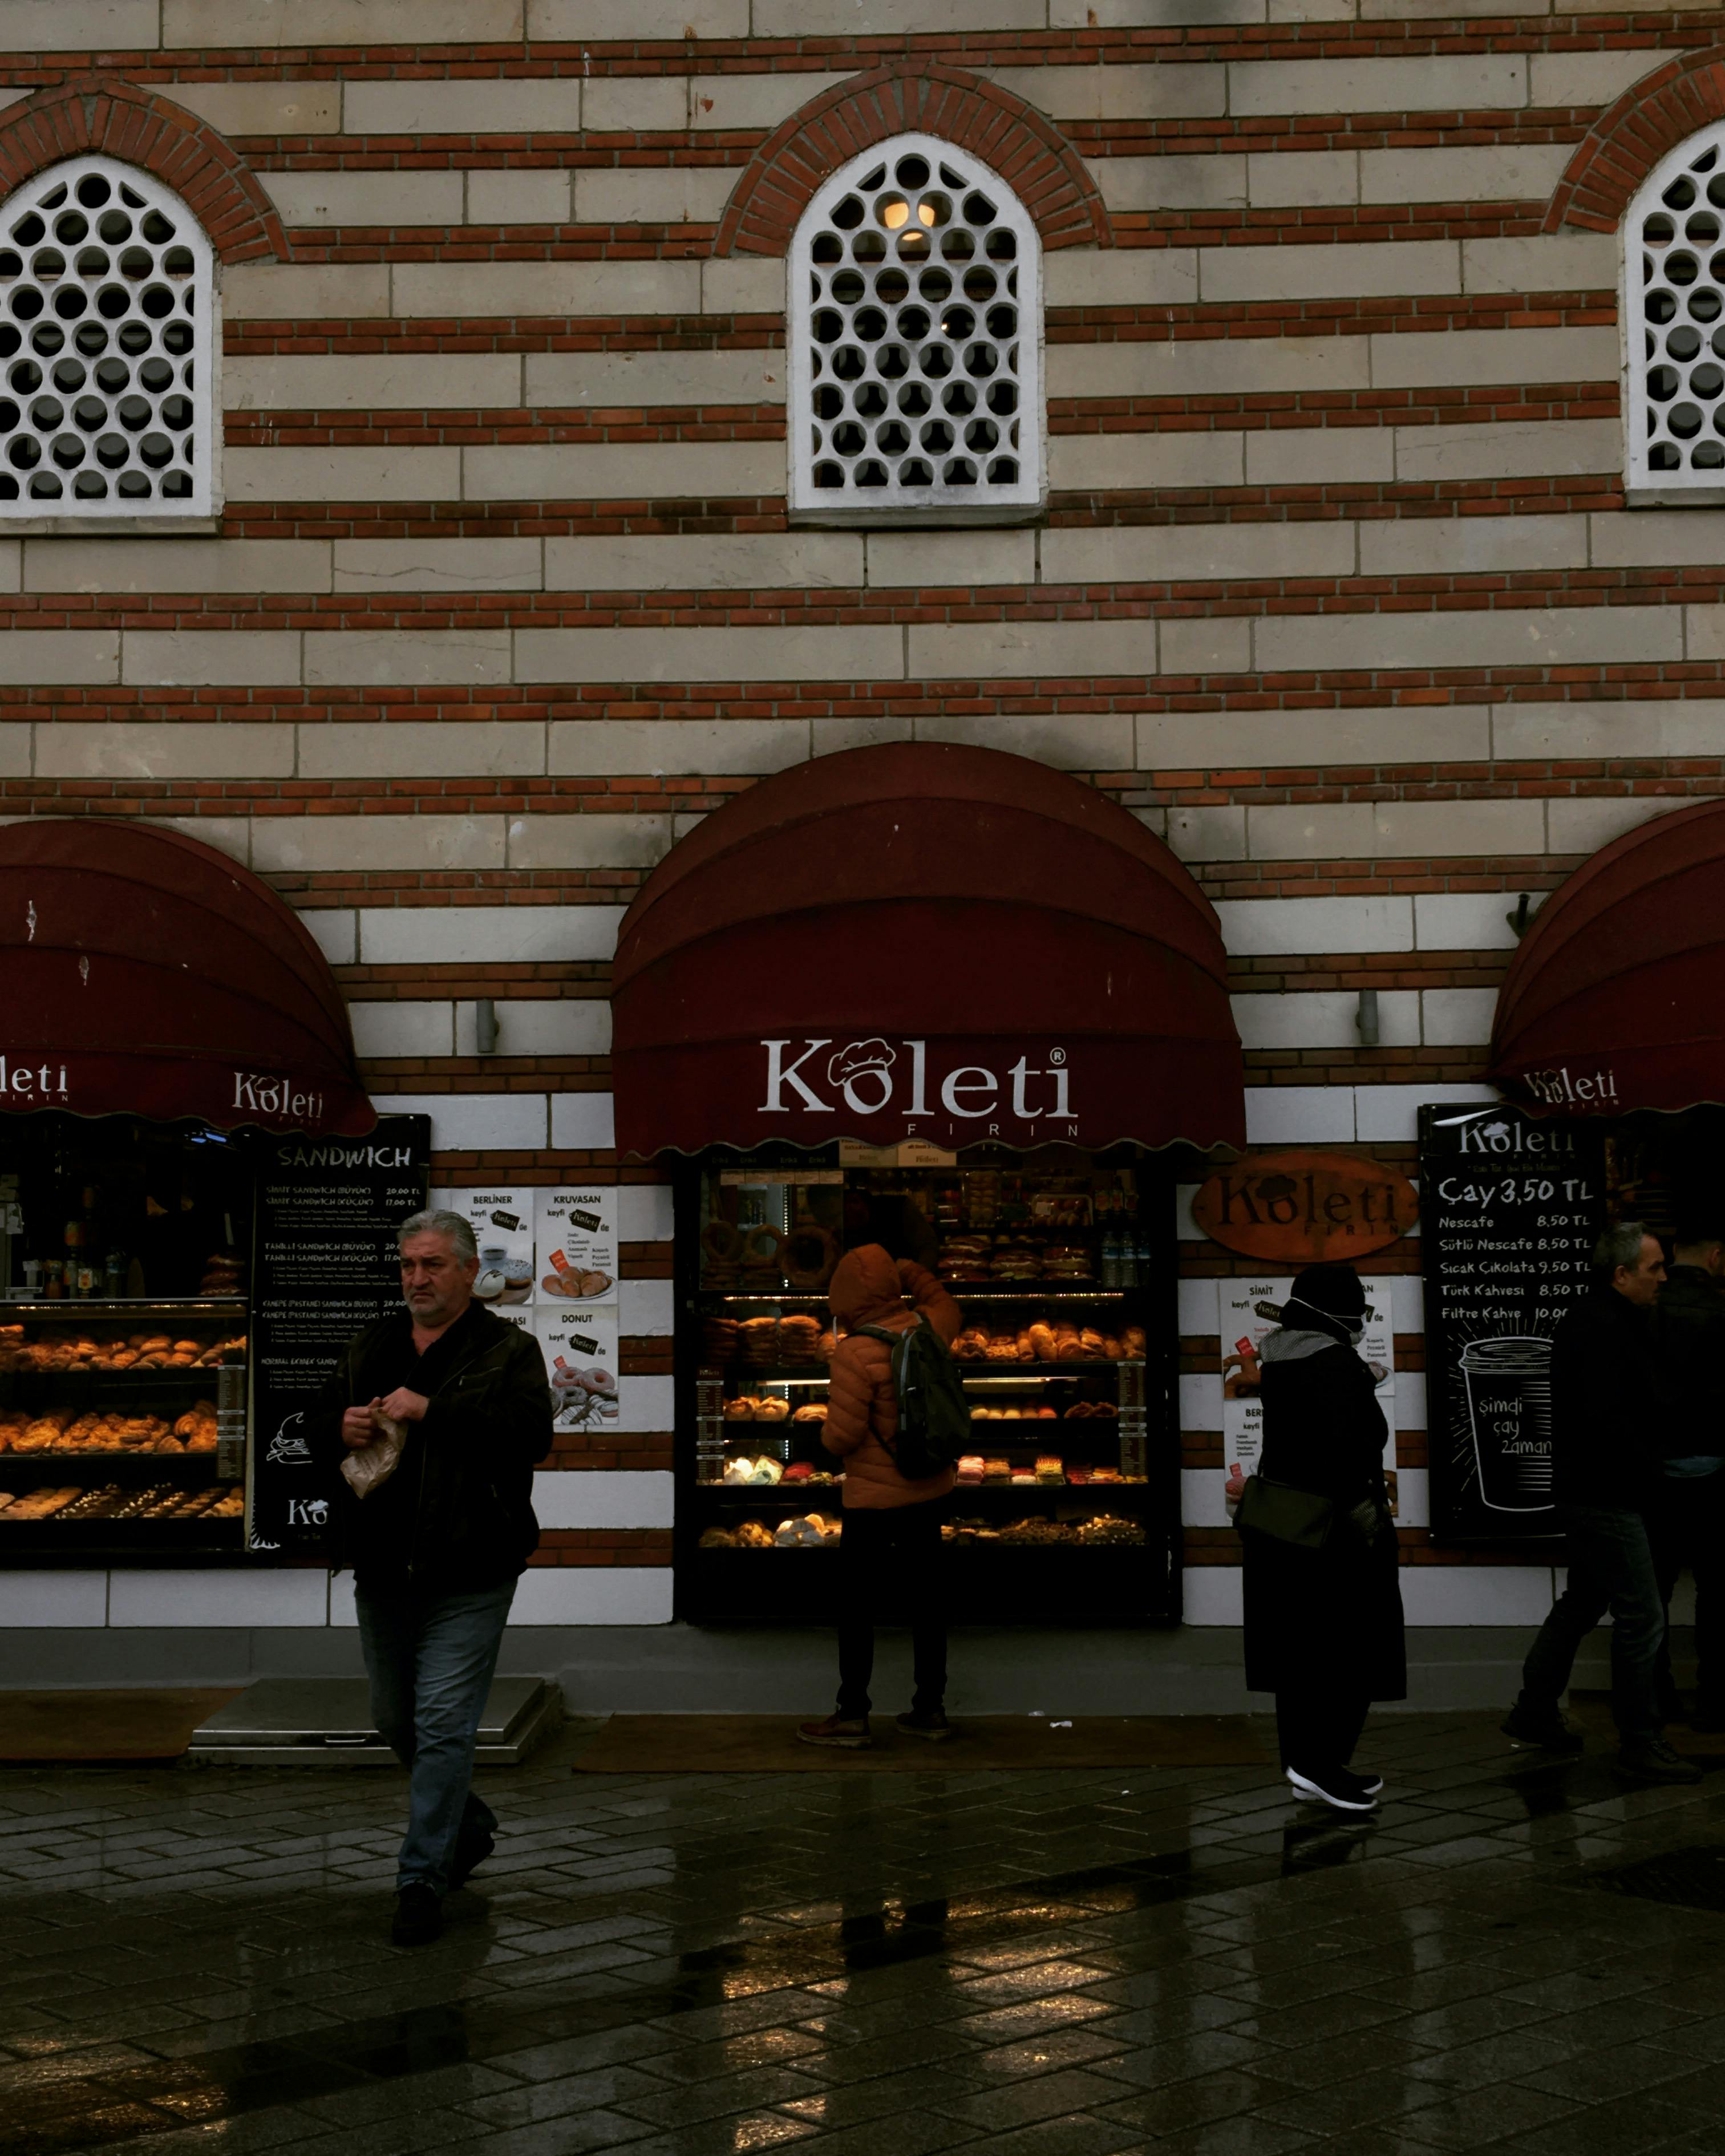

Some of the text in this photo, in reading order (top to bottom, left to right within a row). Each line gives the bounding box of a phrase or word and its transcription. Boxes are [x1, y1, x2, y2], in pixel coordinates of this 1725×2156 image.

[907, 1123, 1078, 1136] FIRIN
[276, 1145, 411, 1168] SANDWICH
[473, 1194, 512, 1204] BERLİNER
[1438, 1177, 1594, 1209] Çay 3,50 TL
[1439, 1215, 1495, 1228] Nescafe
[1572, 1215, 1591, 1226] TL
[1305, 1225, 1399, 1235] FIRIN
[1439, 1238, 1473, 1250] Sütlü
[1477, 1238, 1533, 1250] Nescafe
[1573, 1238, 1592, 1249] TL
[1440, 1261, 1475, 1274] Sıcak
[1479, 1261, 1536, 1275] Çikolata
[1574, 1261, 1592, 1272] TL
[1249, 1284, 1273, 1295] SİMİT
[1440, 1284, 1471, 1296] Türk
[1474, 1284, 1525, 1296] Kahvesi
[1232, 1300, 1249, 1309] keyfi
[1441, 1307, 1479, 1319] Filtre
[1483, 1307, 1521, 1319] Kahve
[1493, 1421, 1520, 1440] çay
